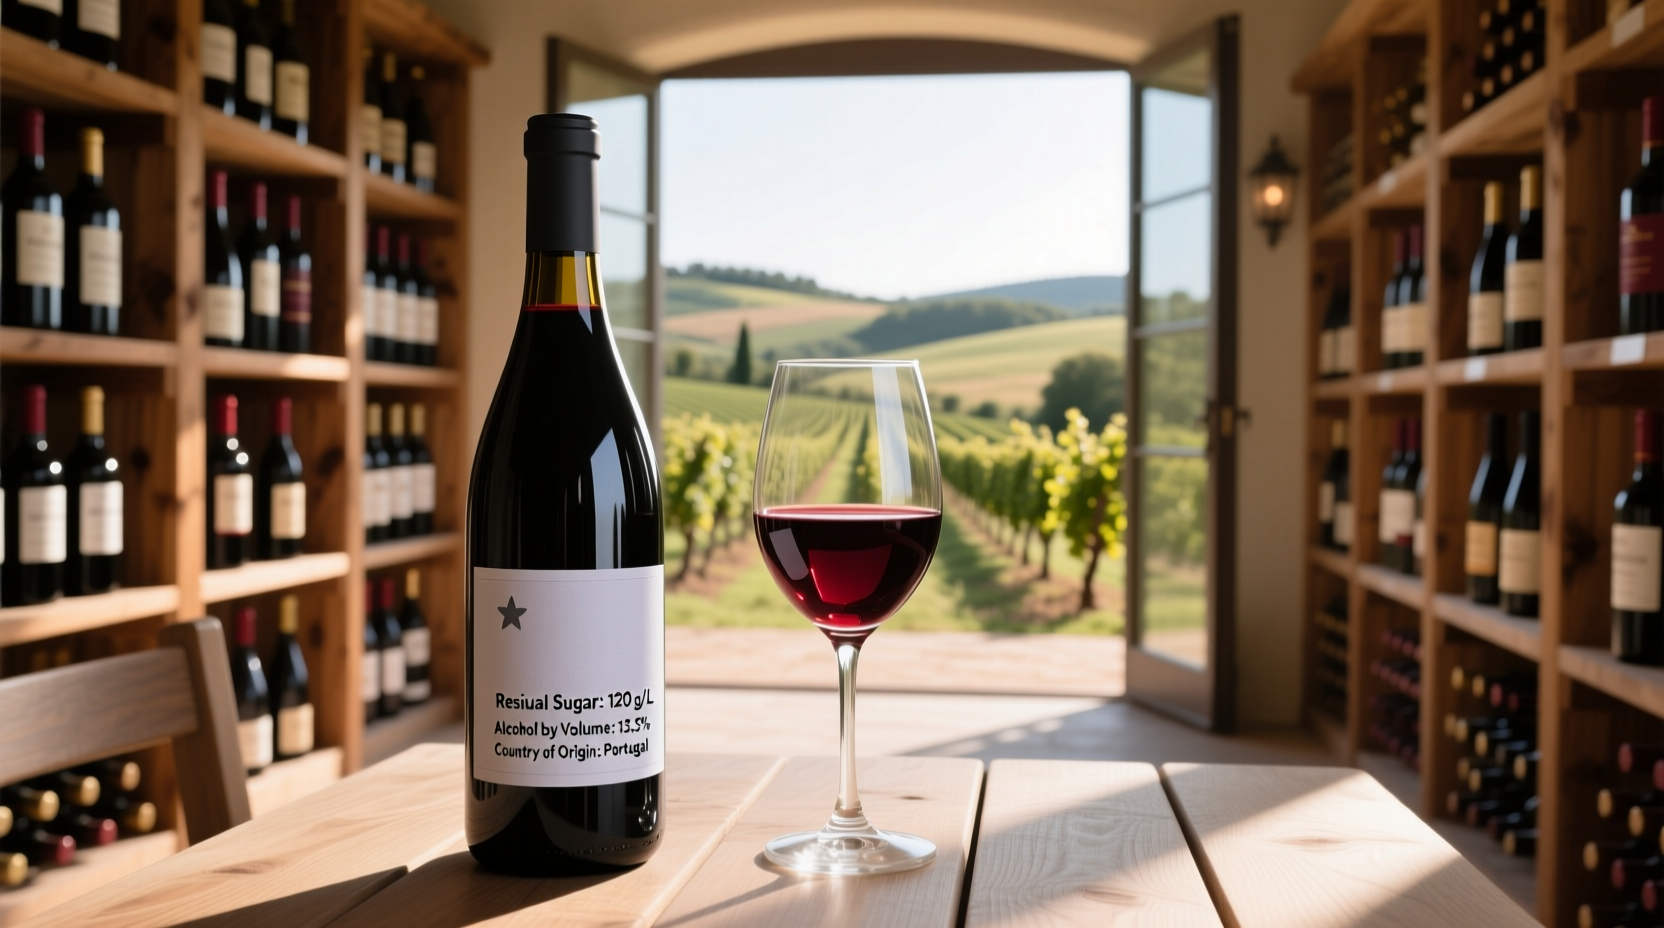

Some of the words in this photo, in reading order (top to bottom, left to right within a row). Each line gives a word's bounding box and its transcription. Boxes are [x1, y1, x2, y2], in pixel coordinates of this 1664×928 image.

[495, 692, 549, 711] Resiual
[552, 693, 604, 715] Sugar:
[608, 690, 632, 709] 120
[634, 688, 655, 711] g/L
[494, 720, 538, 737] Alcohol
[541, 721, 558, 740] by
[560, 720, 616, 737] Volume:
[617, 716, 651, 734] 13.5%
[494, 742, 540, 762] Country
[542, 744, 557, 759] of
[558, 743, 602, 762] Origin:
[603, 737, 649, 758] Portugal
